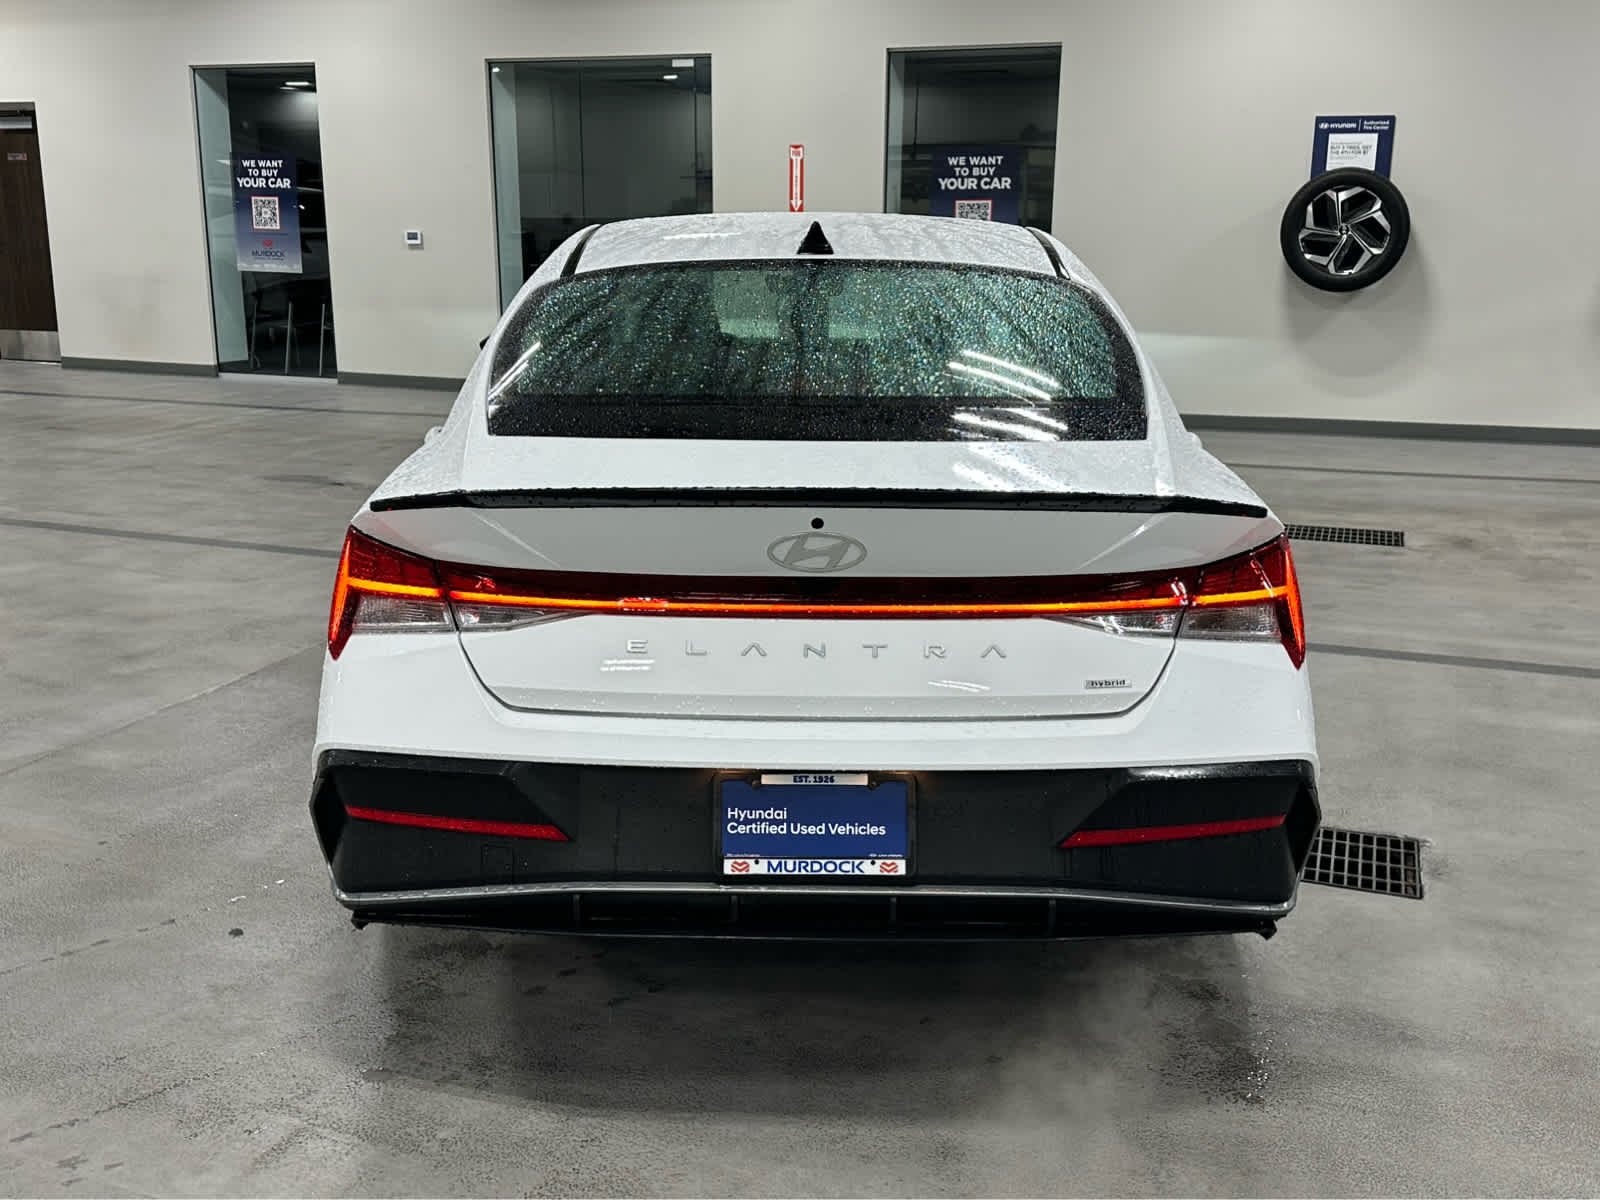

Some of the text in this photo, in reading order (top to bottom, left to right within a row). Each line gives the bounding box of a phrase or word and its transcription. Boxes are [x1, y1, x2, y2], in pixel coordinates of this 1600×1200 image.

[241, 159, 283, 168] WE WANT
[947, 156, 1004, 166] WE WANT
[247, 168, 279, 177] TO BUY
[954, 167, 996, 176] TO BUY
[236, 177, 291, 189] YOUR CAR
[938, 176, 1012, 190] YOUR CAR
[625, 638, 1007, 659] ELANTRA
[1087, 679, 1126, 687] hybrid
[793, 775, 835, 784] EST. 1926
[727, 807, 788, 821] Hyundai
[727, 822, 887, 836] Certified Used Vehicles
[767, 860, 865, 874] MURDOCK
